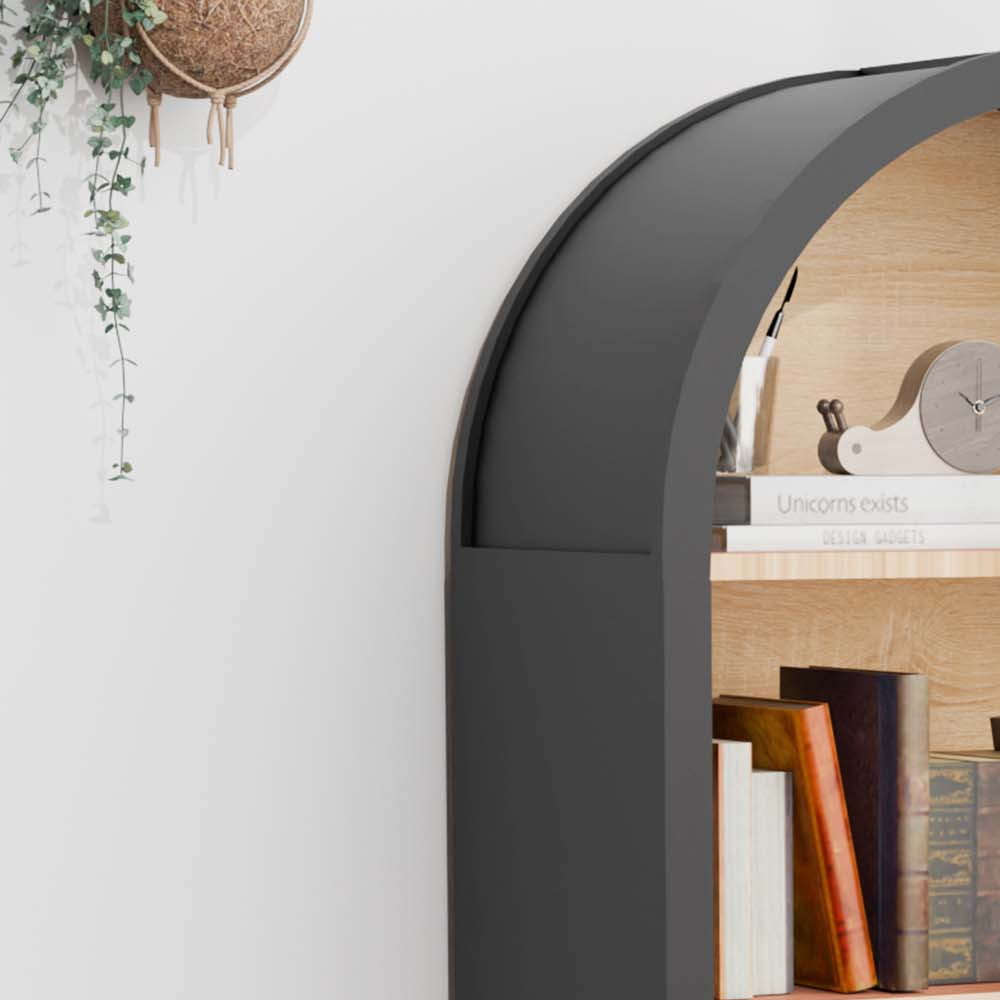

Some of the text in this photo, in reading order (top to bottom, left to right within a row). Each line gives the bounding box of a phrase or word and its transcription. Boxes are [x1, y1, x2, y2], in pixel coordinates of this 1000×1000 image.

[776, 493, 909, 514] Unicorns exists
[823, 528, 926, 545] DESIGN GADGETS
